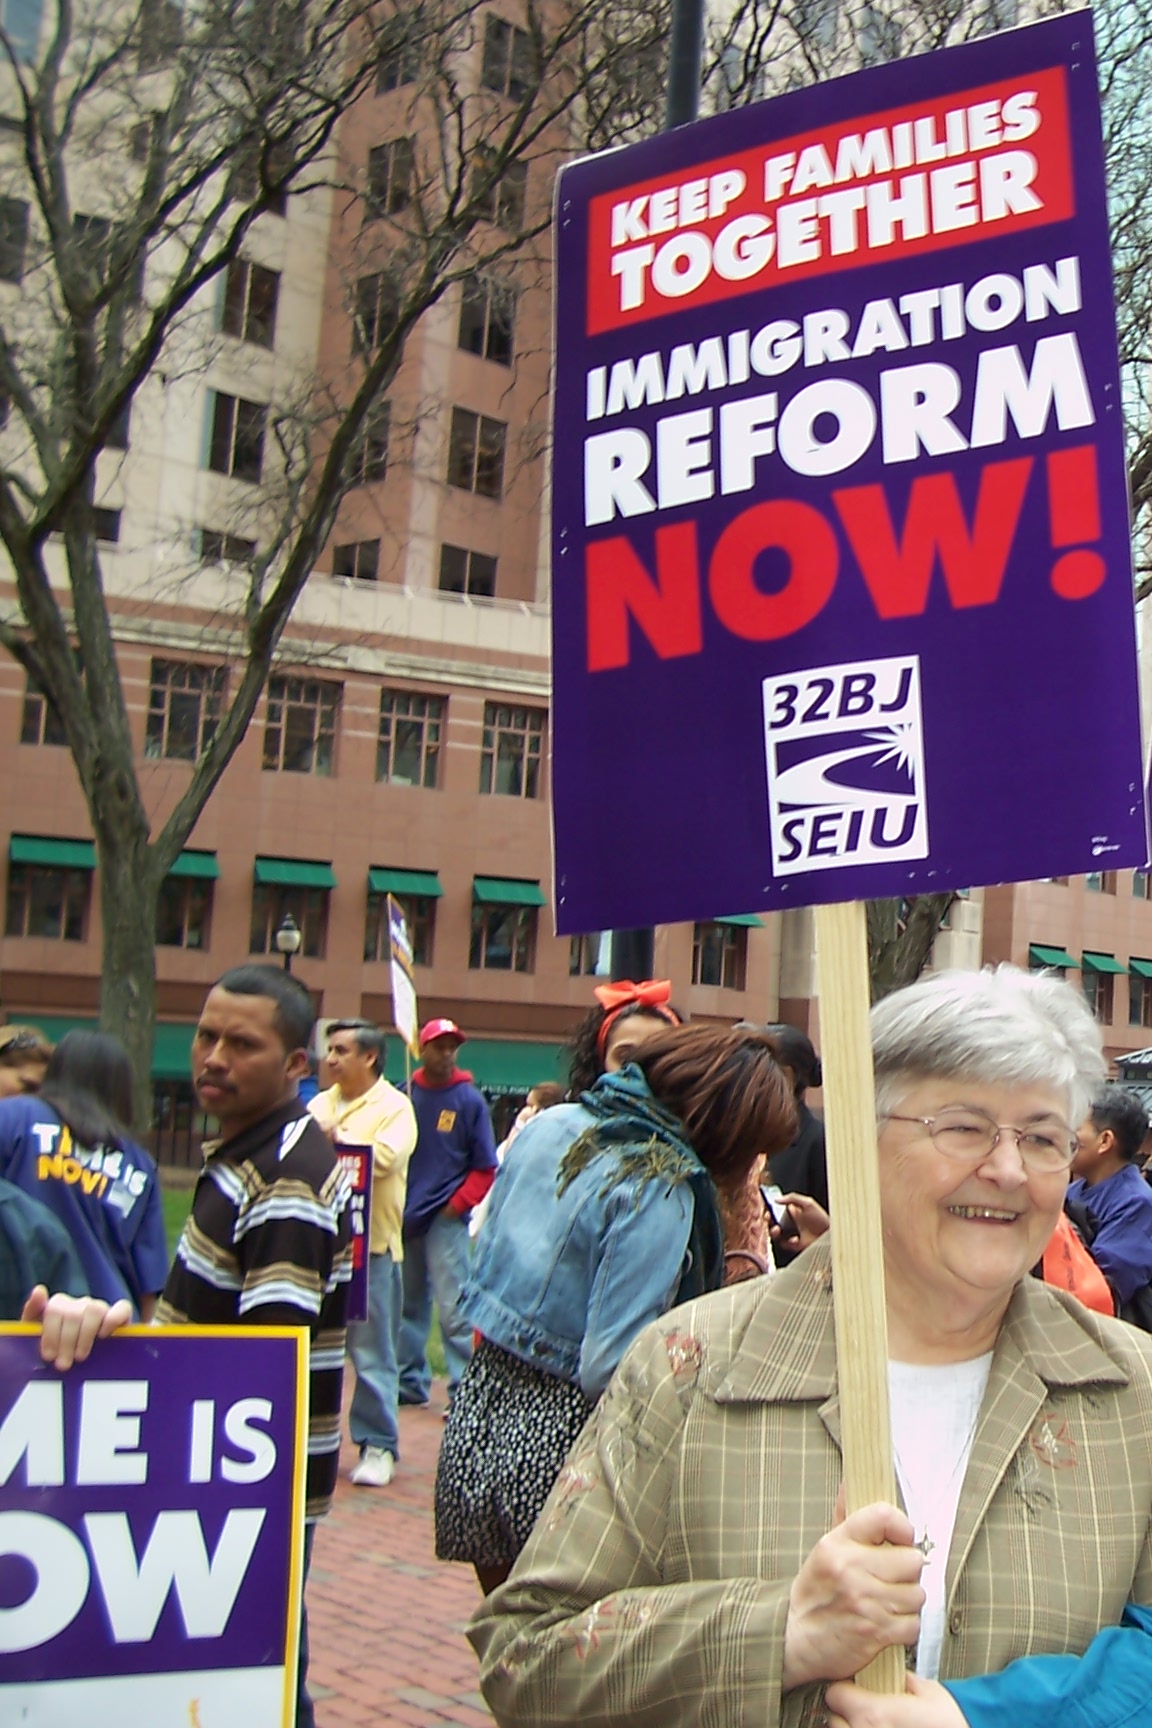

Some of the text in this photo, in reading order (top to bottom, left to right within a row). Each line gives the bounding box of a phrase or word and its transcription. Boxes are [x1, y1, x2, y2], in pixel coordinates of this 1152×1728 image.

[611, 91, 1039, 247] KEEP FAMILIES
[611, 150, 1044, 311] TOGETHER
[586, 257, 1081, 420] IMMIGRATION
[584, 332, 1095, 526] REFORM
[586, 444, 1106, 673] NOW!
[769, 667, 913, 729] 32BJ
[777, 803, 918, 863] SEIU
[123, 1163, 148, 1196] IS
[189, 1398, 277, 1484] IS
